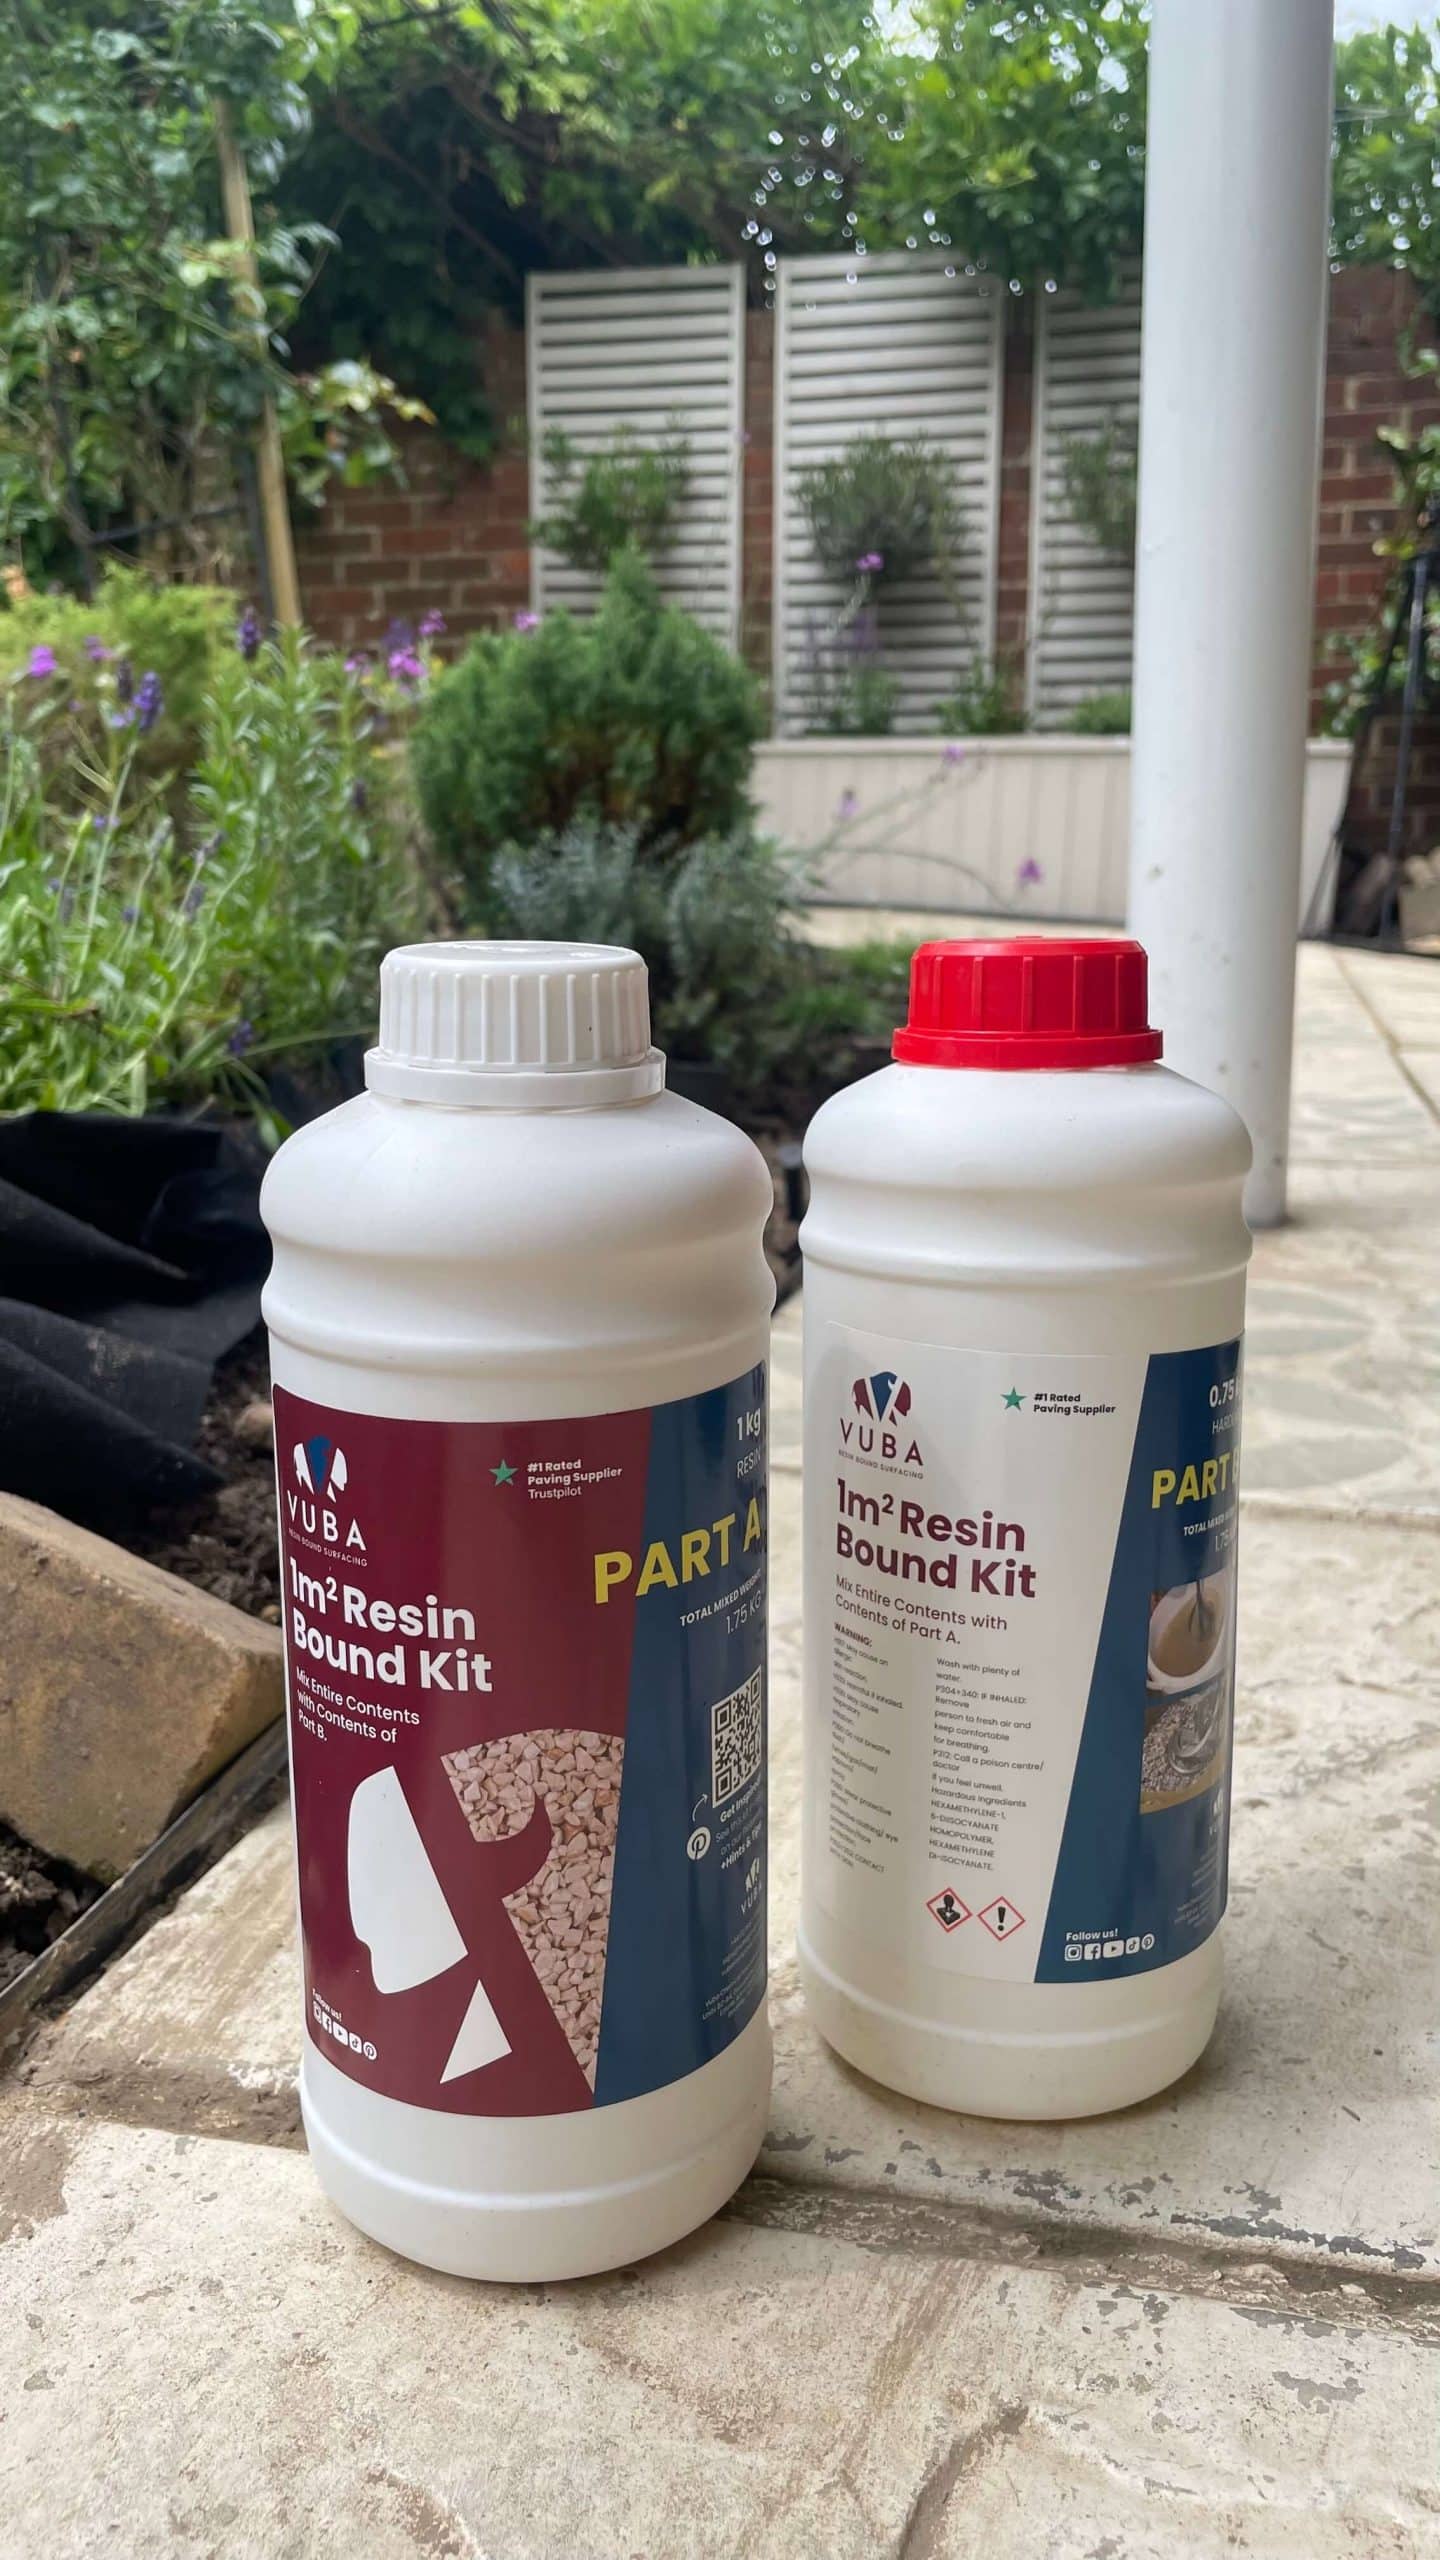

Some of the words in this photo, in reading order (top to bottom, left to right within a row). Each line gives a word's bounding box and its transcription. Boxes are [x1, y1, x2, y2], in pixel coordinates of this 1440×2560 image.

[1034, 1393, 1048, 1402] #1
[1049, 1393, 1081, 1403] Rated
[1209, 1379, 1235, 1408] 0.75
[1033, 1404, 1071, 1416] Paving
[1072, 1404, 1116, 1416] Supplier
[737, 1416, 744, 1441] 1
[746, 1407, 762, 1437] kg
[839, 1417, 924, 1466] VUBA
[527, 1462, 544, 1473] #1
[545, 1459, 582, 1472] Rated
[737, 1446, 762, 1479] RESIN
[855, 1456, 878, 1470] BOUND
[880, 1463, 924, 1480] SURFACING
[527, 1472, 572, 1487] Paving
[573, 1466, 623, 1484] Supplier
[1151, 1453, 1232, 1510] PART
[527, 1486, 582, 1500] Trustpilot
[286, 1489, 368, 1552] VUBA
[900, 1500, 1026, 1552] Resin
[1183, 1520, 1207, 1537] TOTAL
[323, 1547, 368, 1568] SURFACING
[594, 1512, 736, 1605] PART
[743, 1497, 762, 1552] A
[836, 1522, 958, 1590] Bound
[971, 1557, 1037, 1599] Kit
[343, 1584, 477, 1641] Resin
[679, 1608, 713, 1628] TOTAL
[713, 1589, 739, 1611] MIXED
[836, 1574, 853, 1594] Mix
[855, 1584, 891, 1608] Entire
[894, 1598, 967, 1626] Contents
[971, 1614, 1008, 1632] with
[726, 1603, 749, 1635] 1.75
[835, 1593, 889, 1627] Contents
[892, 1617, 907, 1632] of
[910, 1620, 942, 1642] Part
[945, 1630, 961, 1645] A.
[292, 1606, 407, 1687] Bound
[419, 1647, 494, 1693] Kit
[936, 1657, 961, 1670] Wash
[962, 1663, 981, 1673] with
[981, 1665, 1011, 1678] plenty
[1011, 1668, 1021, 1677] of
[296, 1665, 310, 1690] Mix
[311, 1678, 343, 1707] Entire
[345, 1695, 420, 1726] Contents
[935, 1695, 970, 1709] Remove
[296, 1688, 316, 1714] with
[316, 1703, 377, 1740] Contents
[380, 1727, 398, 1744] of
[298, 1708, 316, 1736] Part
[317, 1723, 329, 1742] B.
[934, 1709, 965, 1722] person
[965, 1714, 975, 1723] to
[976, 1715, 998, 1727] fresh
[999, 1719, 1013, 1728] air
[1013, 1720, 1032, 1729] and
[934, 1721, 955, 1735] keep
[955, 1726, 1010, 1742] comfortable
[934, 1735, 946, 1745] for
[932, 1759, 960, 1771] doctor
[953, 1752, 971, 1763] Call
[980, 1758, 1010, 1769] poison
[938, 1774, 955, 1785] you
[955, 1776, 972, 1787] feel
[931, 1785, 976, 1801] Hazardous
[977, 1794, 1027, 1808] ingredients
[1065, 1931, 1101, 1942] Follow
[1102, 1928, 1119, 1938] us!
